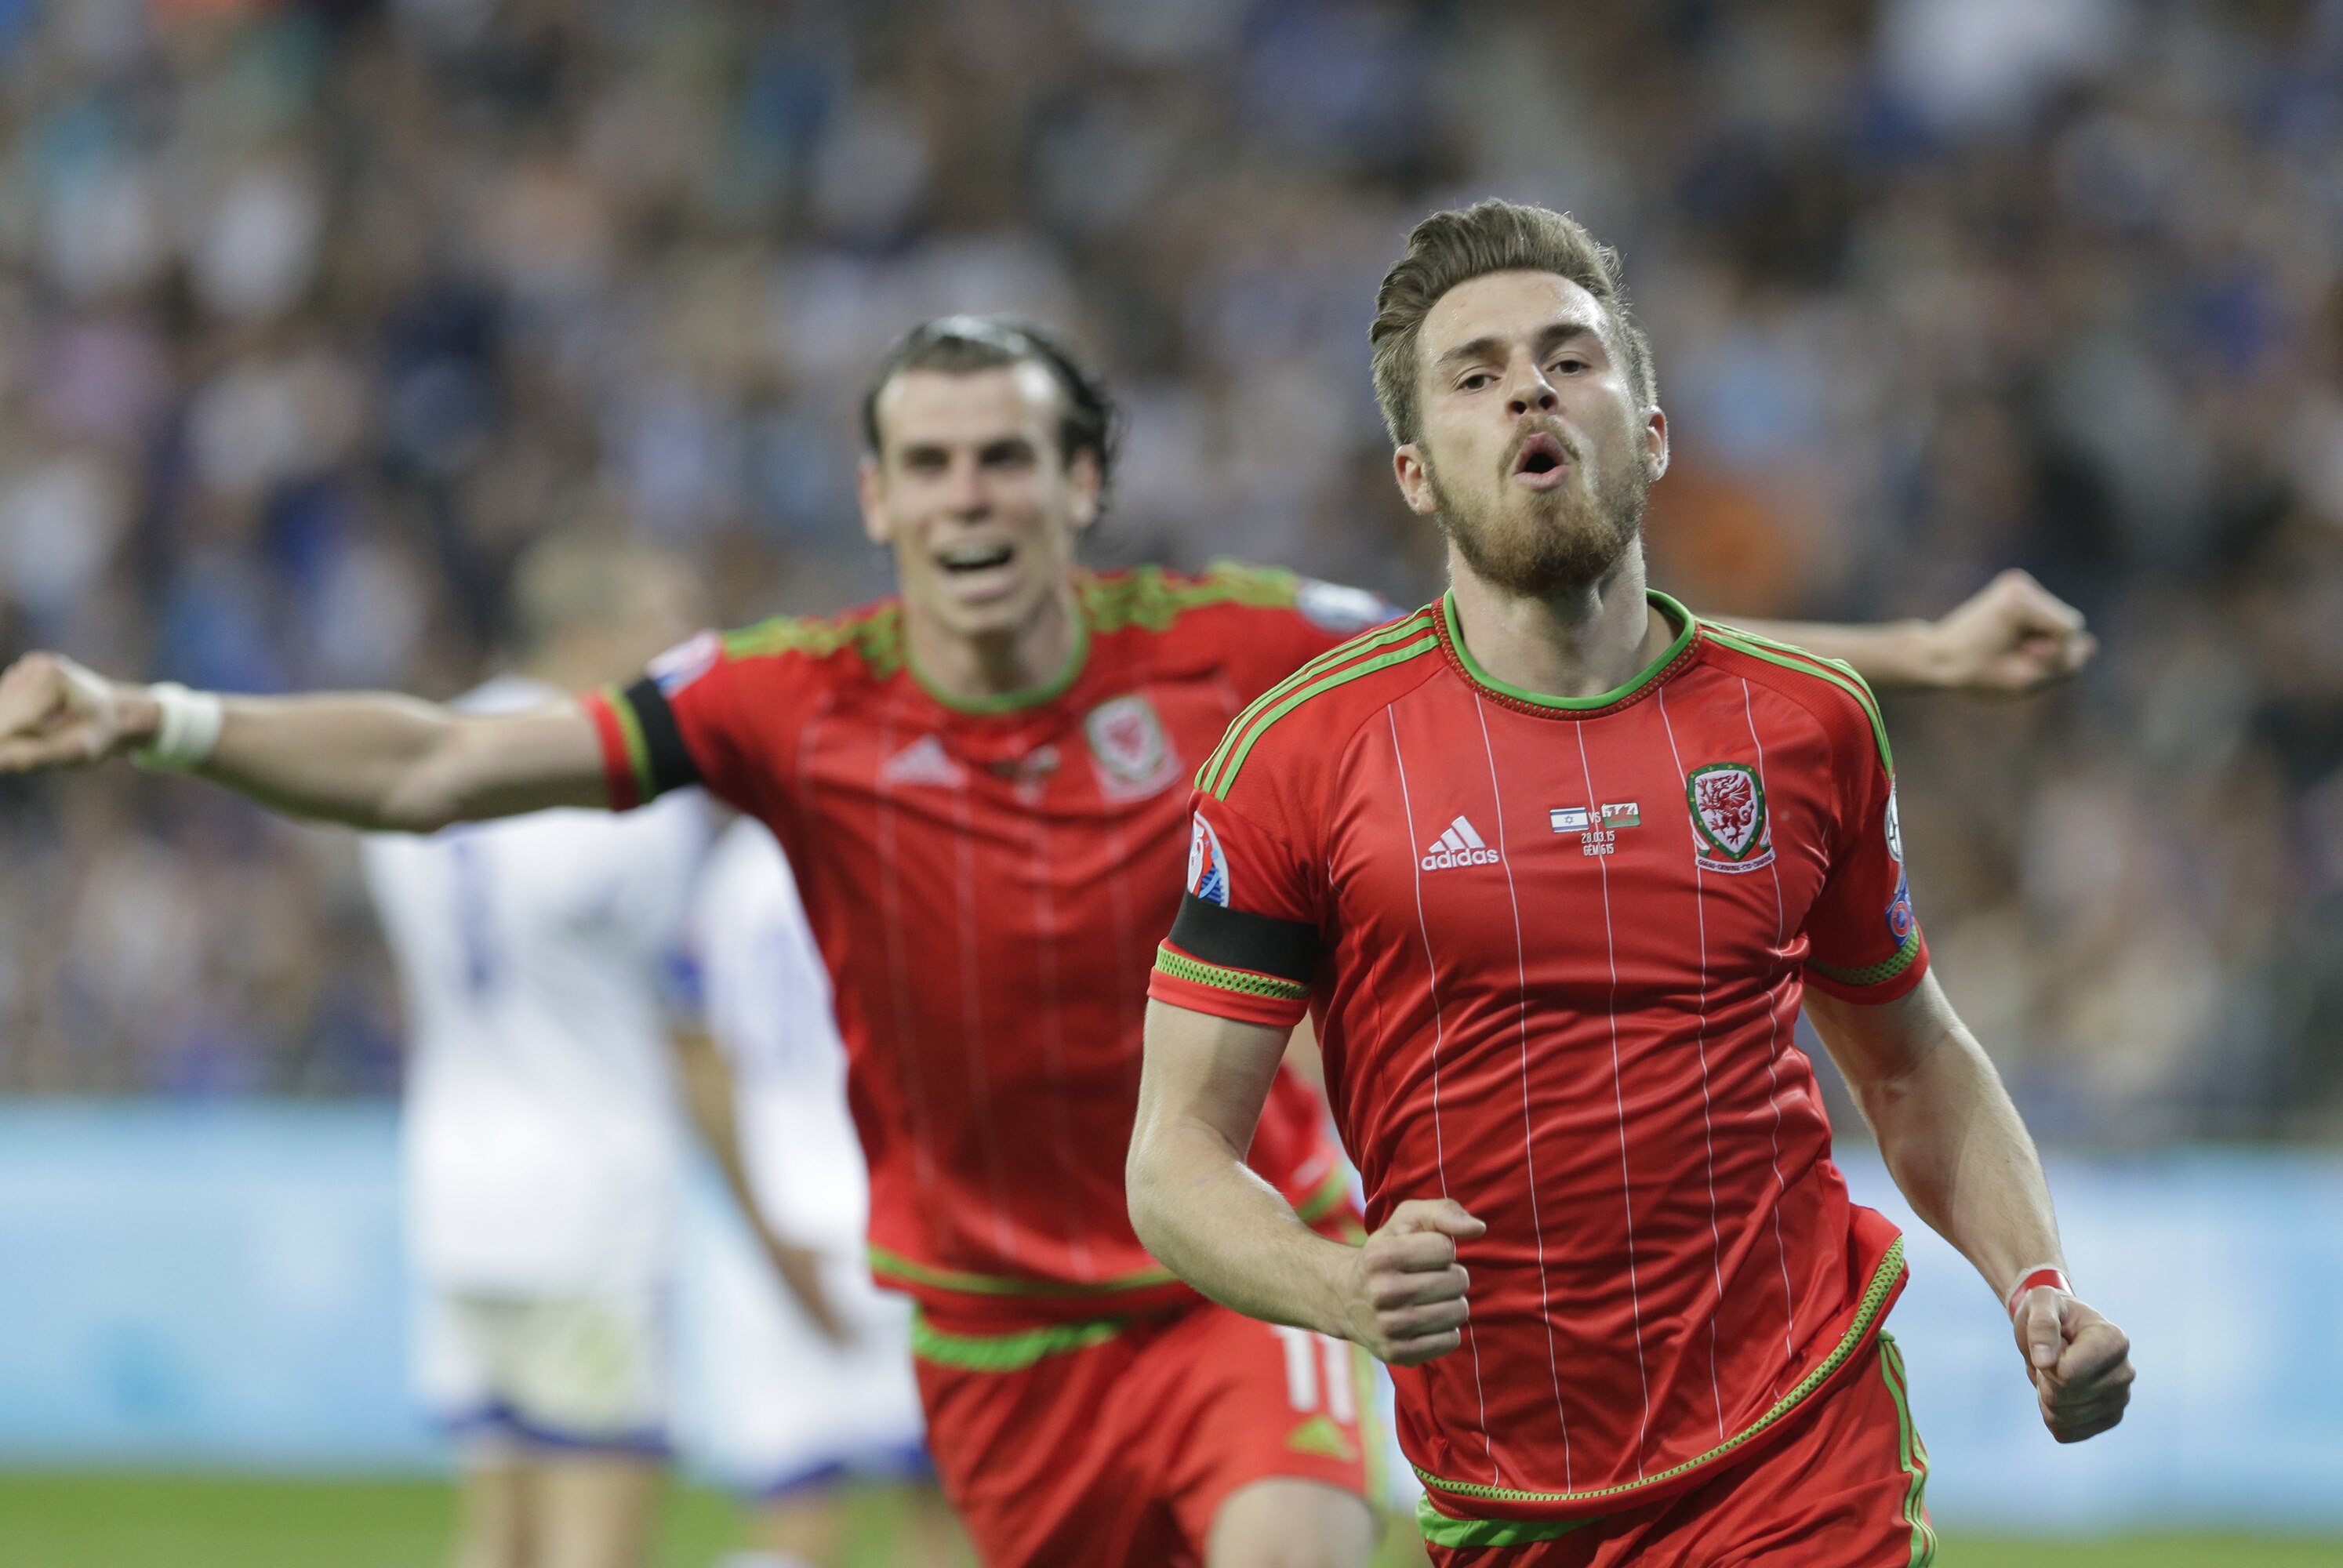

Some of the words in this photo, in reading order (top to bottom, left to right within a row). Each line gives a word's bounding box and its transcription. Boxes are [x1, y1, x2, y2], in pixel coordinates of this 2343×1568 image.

[1581, 830, 1615, 844] 28.03.15
[1422, 847, 1500, 871] adidas
[1272, 1325, 1354, 1424] 11
